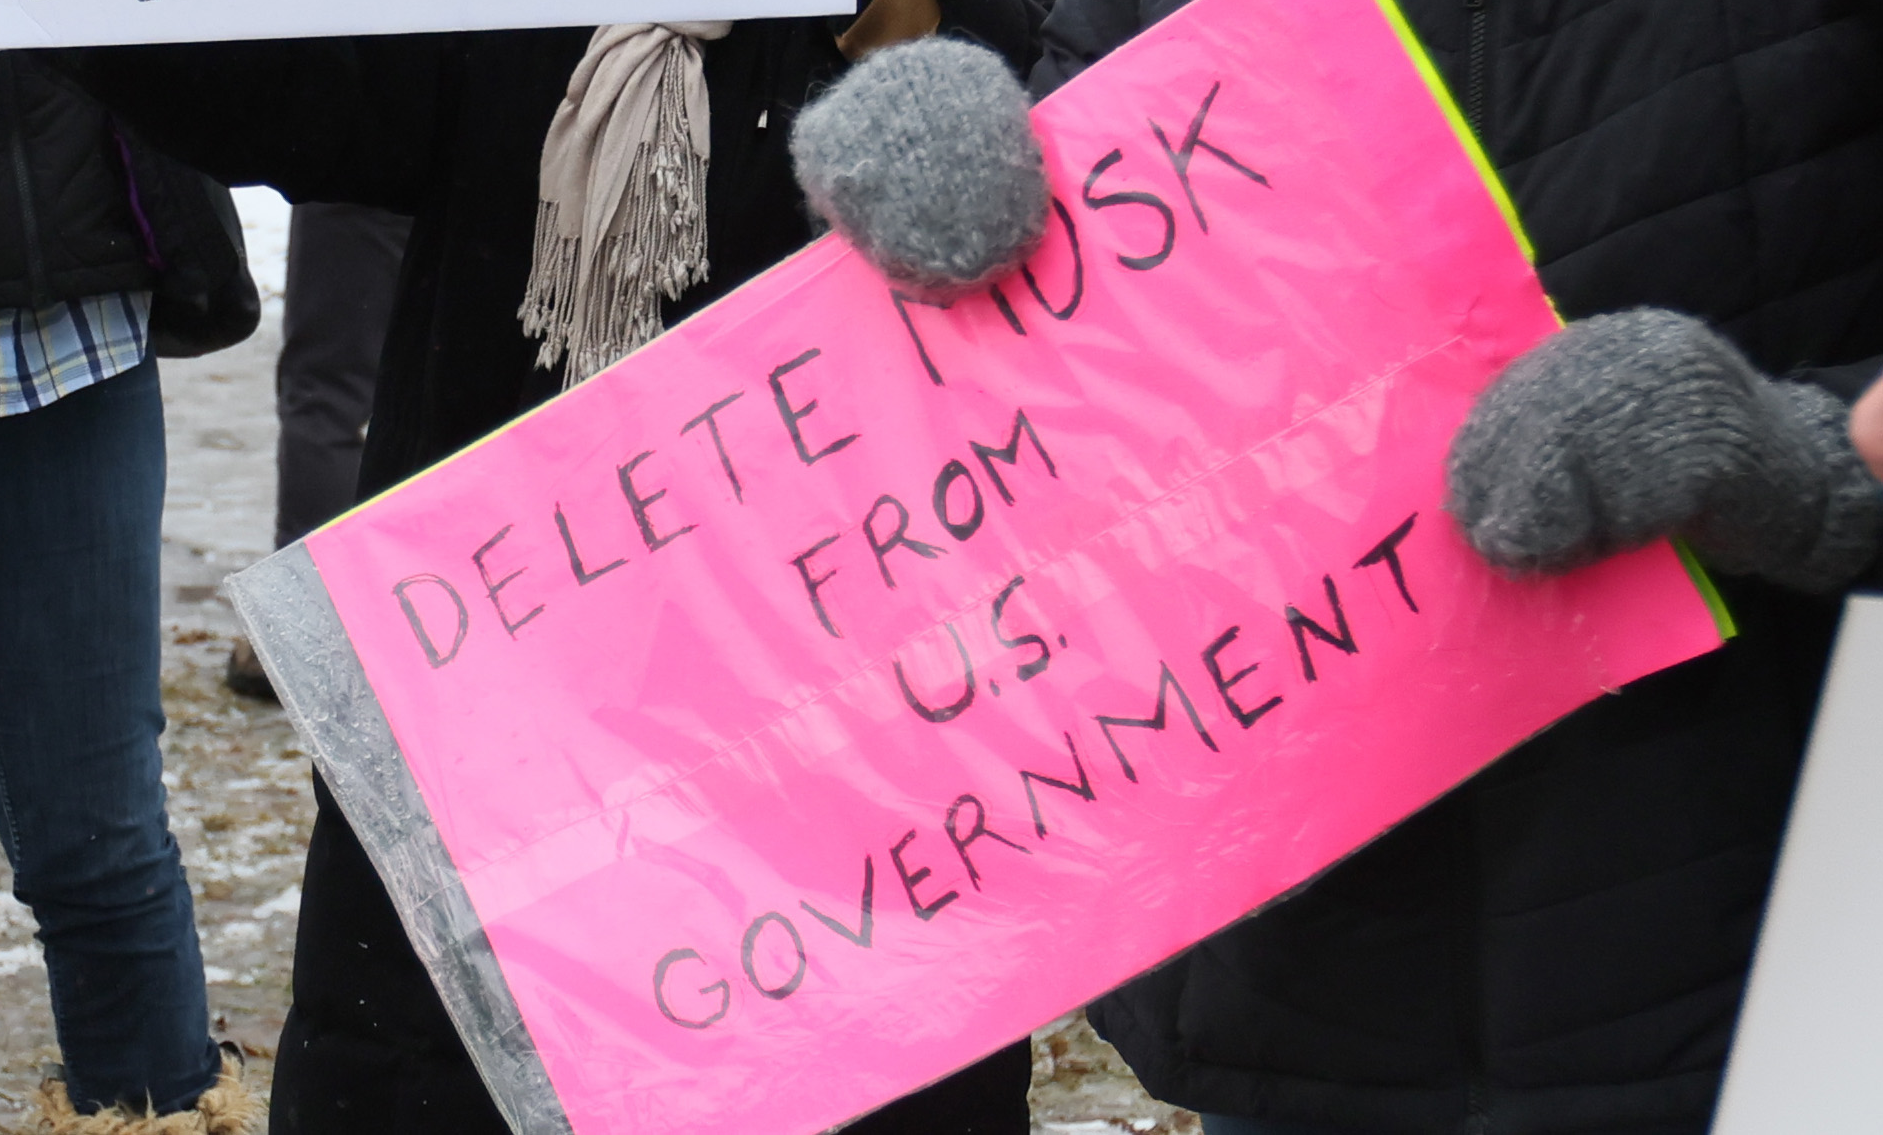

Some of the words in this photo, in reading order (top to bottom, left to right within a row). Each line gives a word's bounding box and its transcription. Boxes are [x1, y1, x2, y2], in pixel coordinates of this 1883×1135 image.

[393, 347, 861, 669] DELETE
[787, 410, 1058, 640] FROM
[651, 512, 1424, 1031] GOVERNMENT
[890, 575, 1069, 724] U.S.
